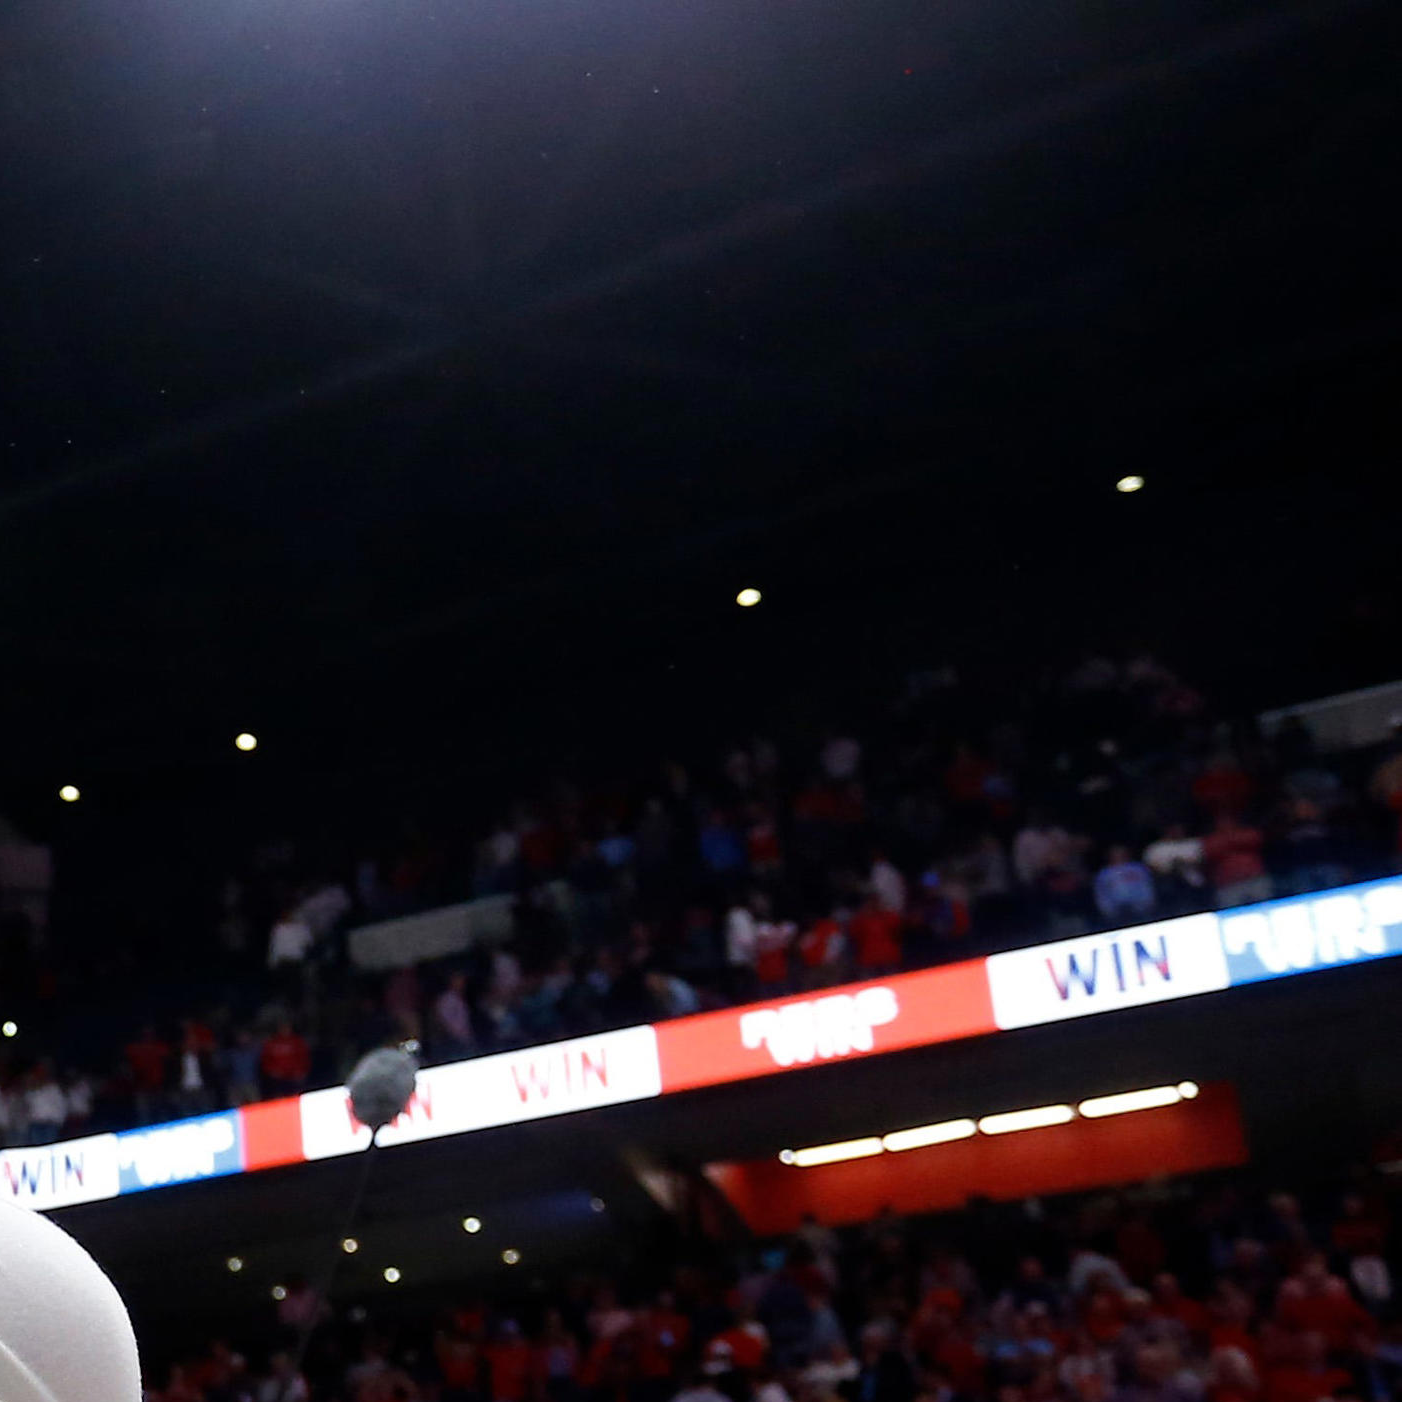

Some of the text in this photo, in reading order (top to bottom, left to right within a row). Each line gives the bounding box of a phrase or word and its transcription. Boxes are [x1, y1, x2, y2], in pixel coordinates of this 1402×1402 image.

[1044, 934, 1173, 1002] WIN
[510, 1046, 610, 1104] WIN
[3, 1149, 85, 1197] WIN
